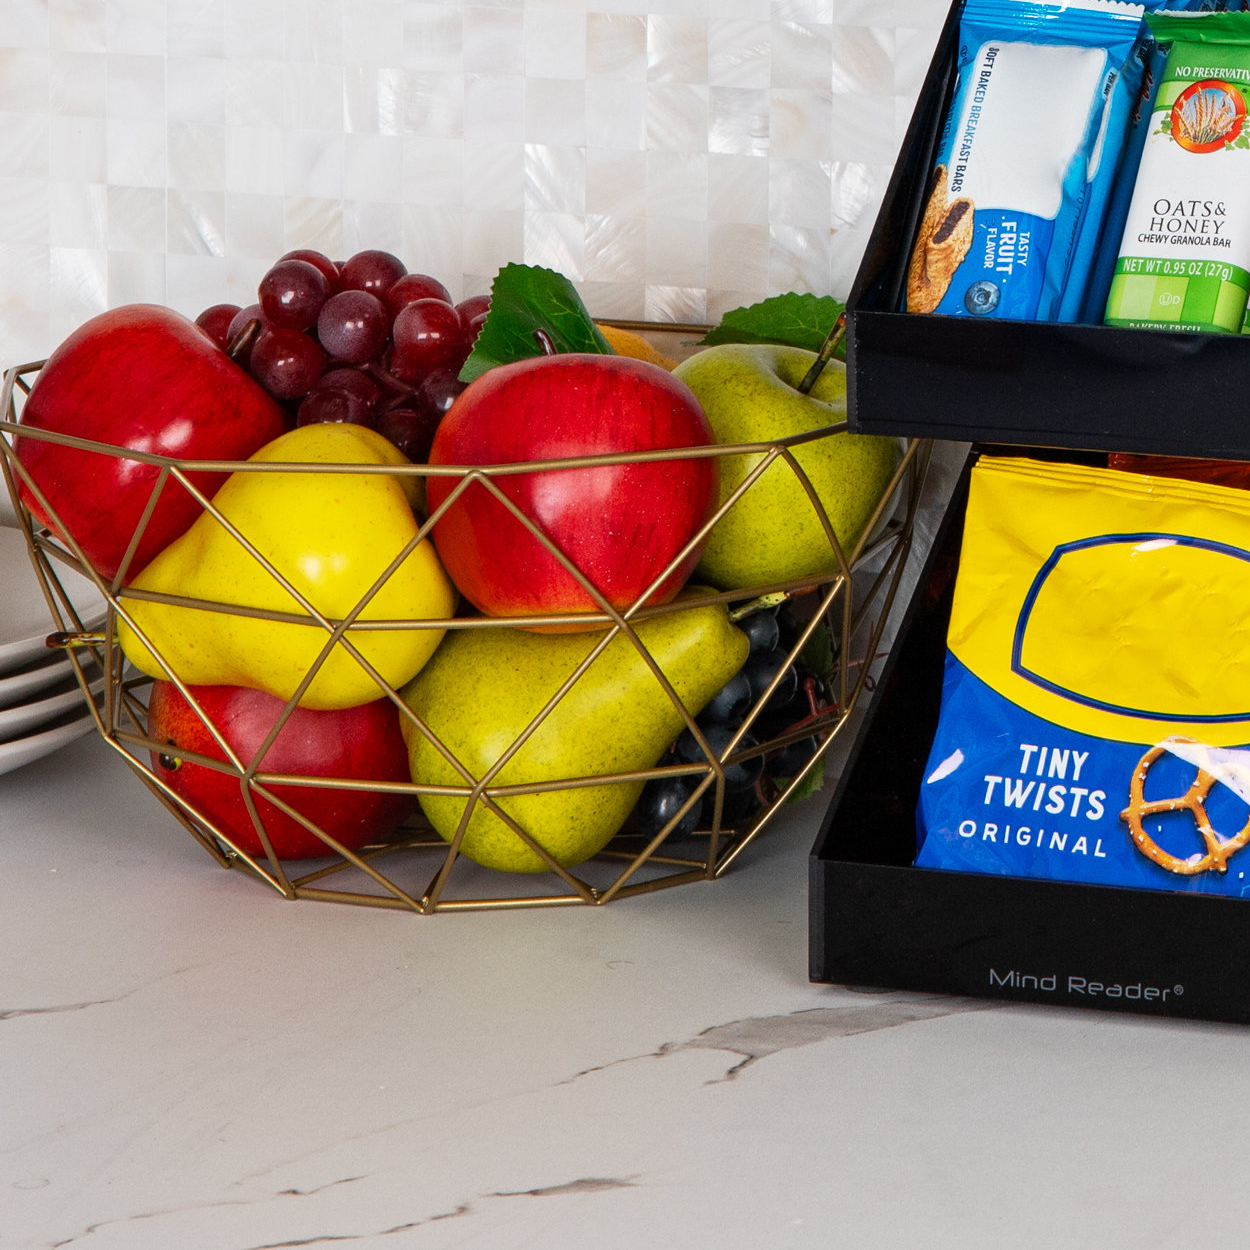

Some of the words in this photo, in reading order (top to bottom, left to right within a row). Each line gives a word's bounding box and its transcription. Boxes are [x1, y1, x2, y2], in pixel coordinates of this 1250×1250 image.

[983, 46, 1000, 70] SOFT
[1175, 66, 1191, 77] NO
[975, 70, 992, 103] BAKED
[958, 105, 982, 163] BREAKFAST
[951, 165, 967, 193] BARS
[1137, 233, 1169, 245] CHEWY
[1170, 234, 1211, 246] GRANOLA
[1212, 236, 1232, 249] BAR
[1149, 217, 1225, 235] HONEY
[983, 227, 998, 269] FLAVOR
[996, 221, 1017, 275] FRUIT
[1016, 231, 1031, 268] TASTY
[1123, 258, 1144, 272] NET
[1145, 260, 1162, 273] WT
[1163, 261, 1186, 275] 0.95
[1188, 262, 1203, 276] OZ
[1204, 263, 1234, 282] (27g)
[1019, 743, 1089, 781] TINY
[984, 775, 1107, 821] TWISTS
[958, 819, 1107, 858] ORIGINAL
[989, 968, 1057, 991] Mind
